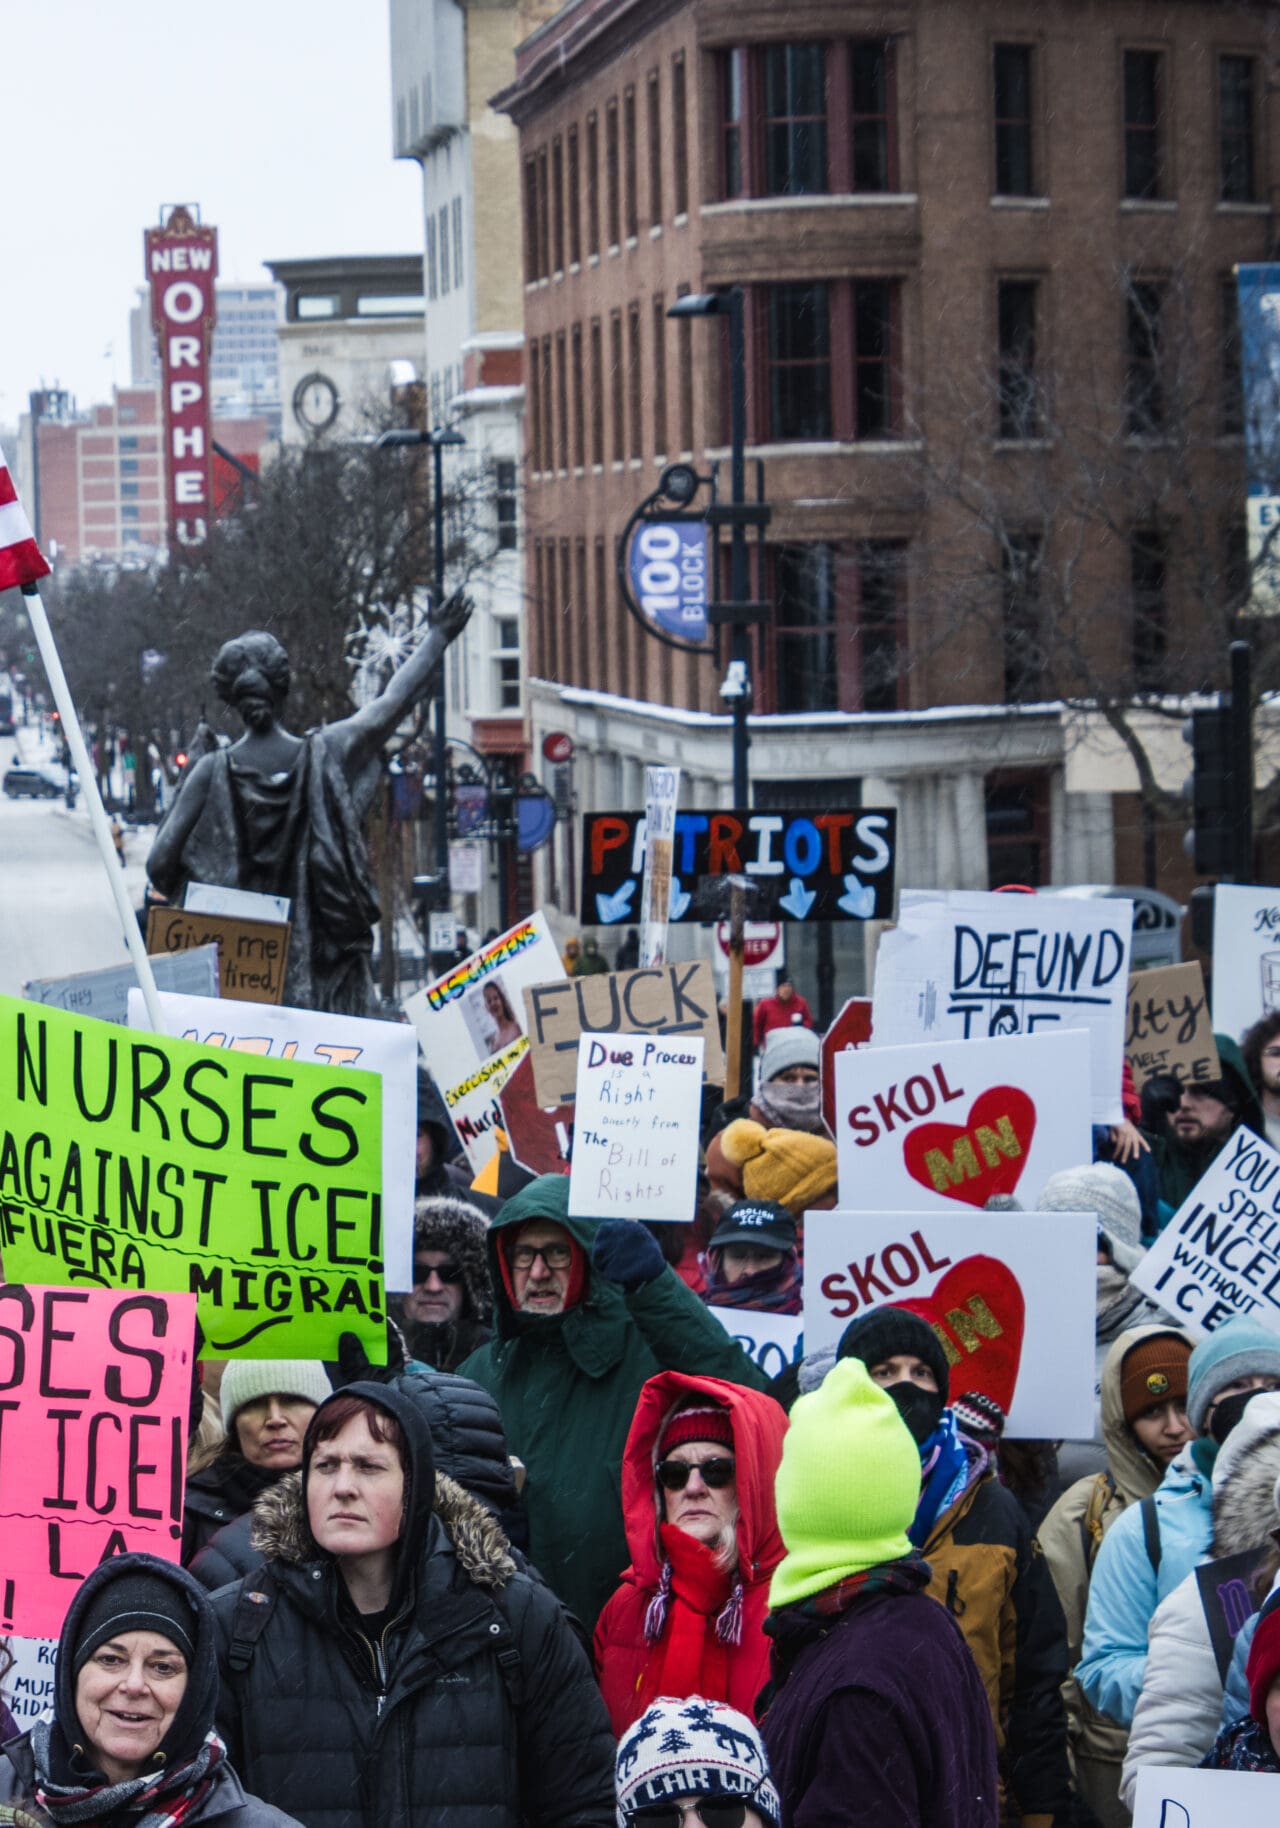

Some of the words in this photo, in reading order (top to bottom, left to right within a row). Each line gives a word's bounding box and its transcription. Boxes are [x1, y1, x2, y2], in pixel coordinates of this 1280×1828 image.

[151, 247, 212, 272] NEW
[639, 525, 680, 618] 100
[681, 541, 705, 622] BLOCK
[236, 935, 280, 960] me
[434, 929, 453, 947] 15
[954, 925, 1124, 994] DEFUND
[224, 959, 277, 994] tired,
[531, 963, 709, 1044] FUCK
[587, 1040, 633, 1069] Due
[16, 1011, 368, 1167] NURSES
[599, 1080, 656, 1106] Right
[848, 1062, 965, 1148] SKOL
[582, 1131, 608, 1148] The
[651, 1115, 680, 1129] from
[607, 1142, 649, 1167] Bill
[660, 1154, 677, 1167] of
[923, 1114, 1023, 1193] MN
[1224, 1133, 1280, 1194] YOU
[597, 1167, 664, 1203] Rights
[731, 1208, 775, 1221] ABOLISH
[250, 1179, 386, 1275] ICE!
[739, 1214, 763, 1226] ICE
[188, 1262, 386, 1325] MIGRA!
[820, 1230, 952, 1318] SKOL
[1154, 1265, 1237, 1333] ICE
[1173, 1241, 1264, 1315] WITHOUT
[43, 1408, 184, 1540] ICE!
